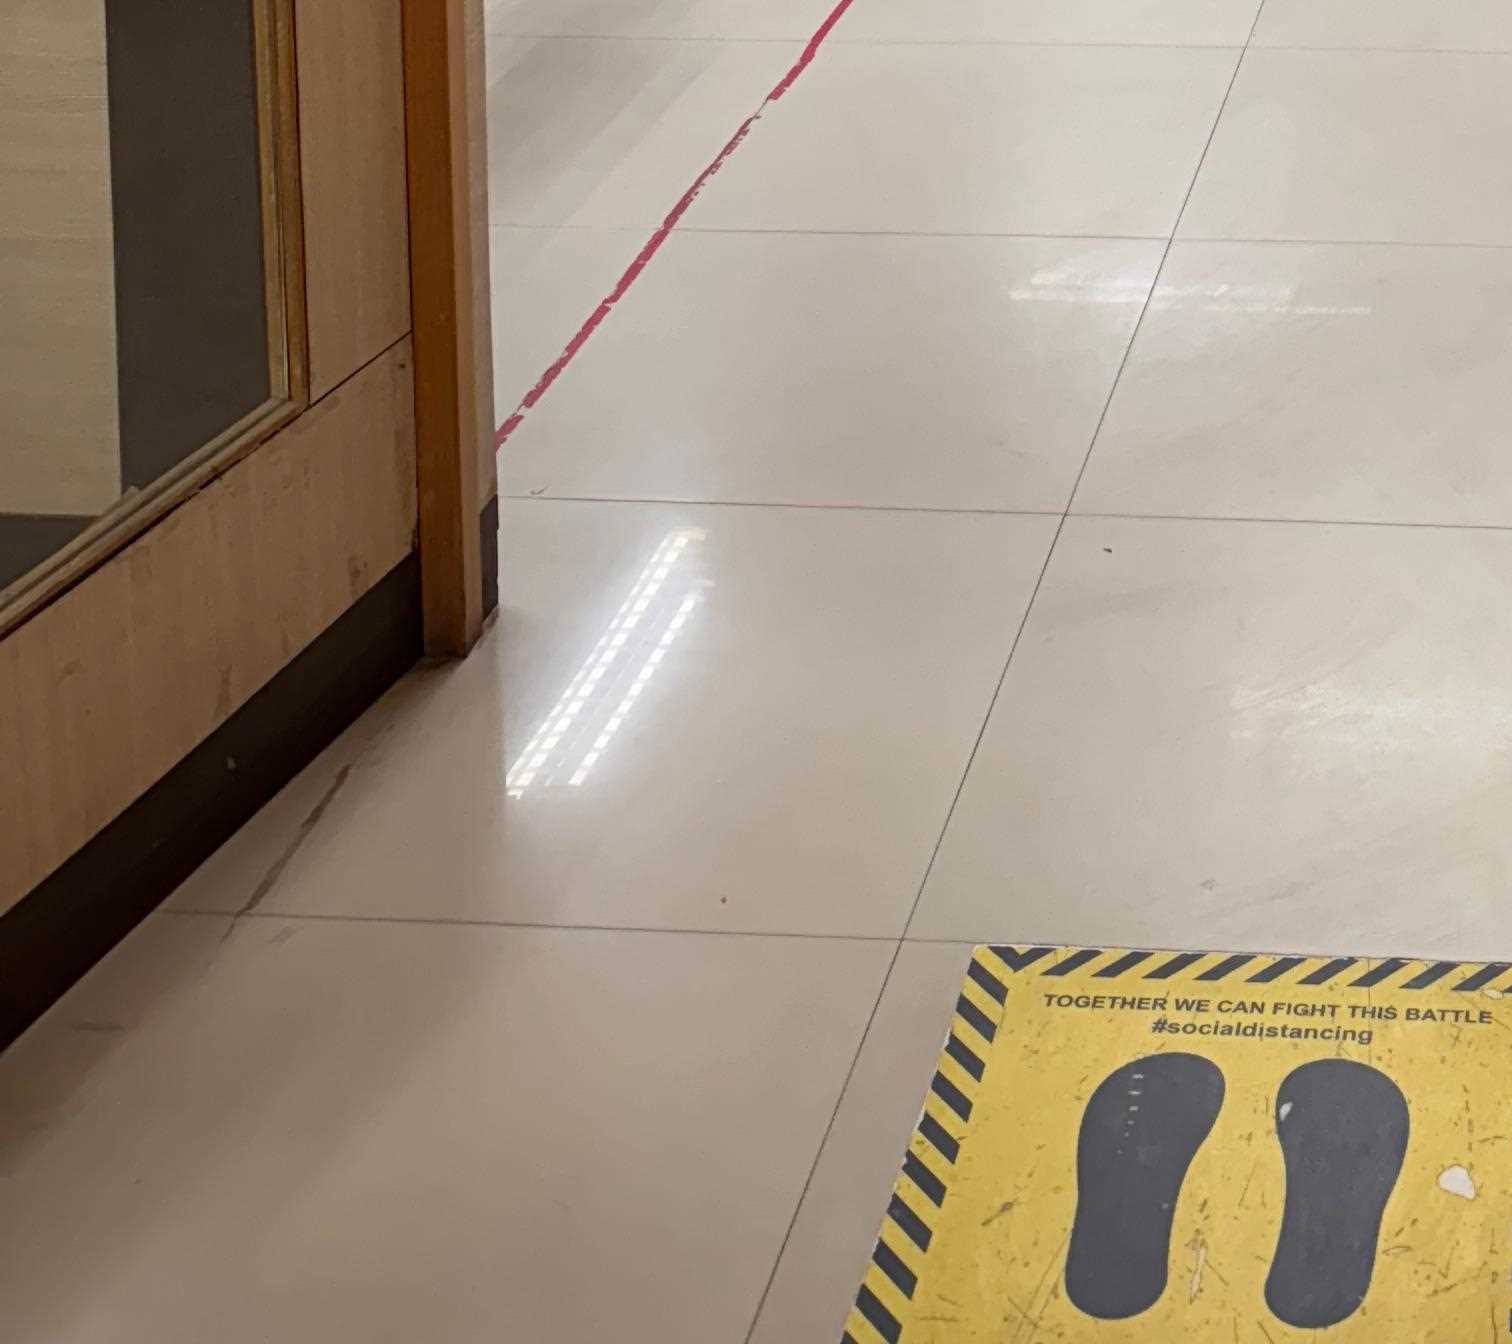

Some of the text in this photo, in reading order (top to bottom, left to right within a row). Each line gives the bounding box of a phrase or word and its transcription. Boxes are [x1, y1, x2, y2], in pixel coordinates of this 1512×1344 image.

[1043, 994, 1493, 1025] TOGETHER WE CAN FIGHT THIS BATTLE
[1151, 1017, 1374, 1045] #socialdistancing
